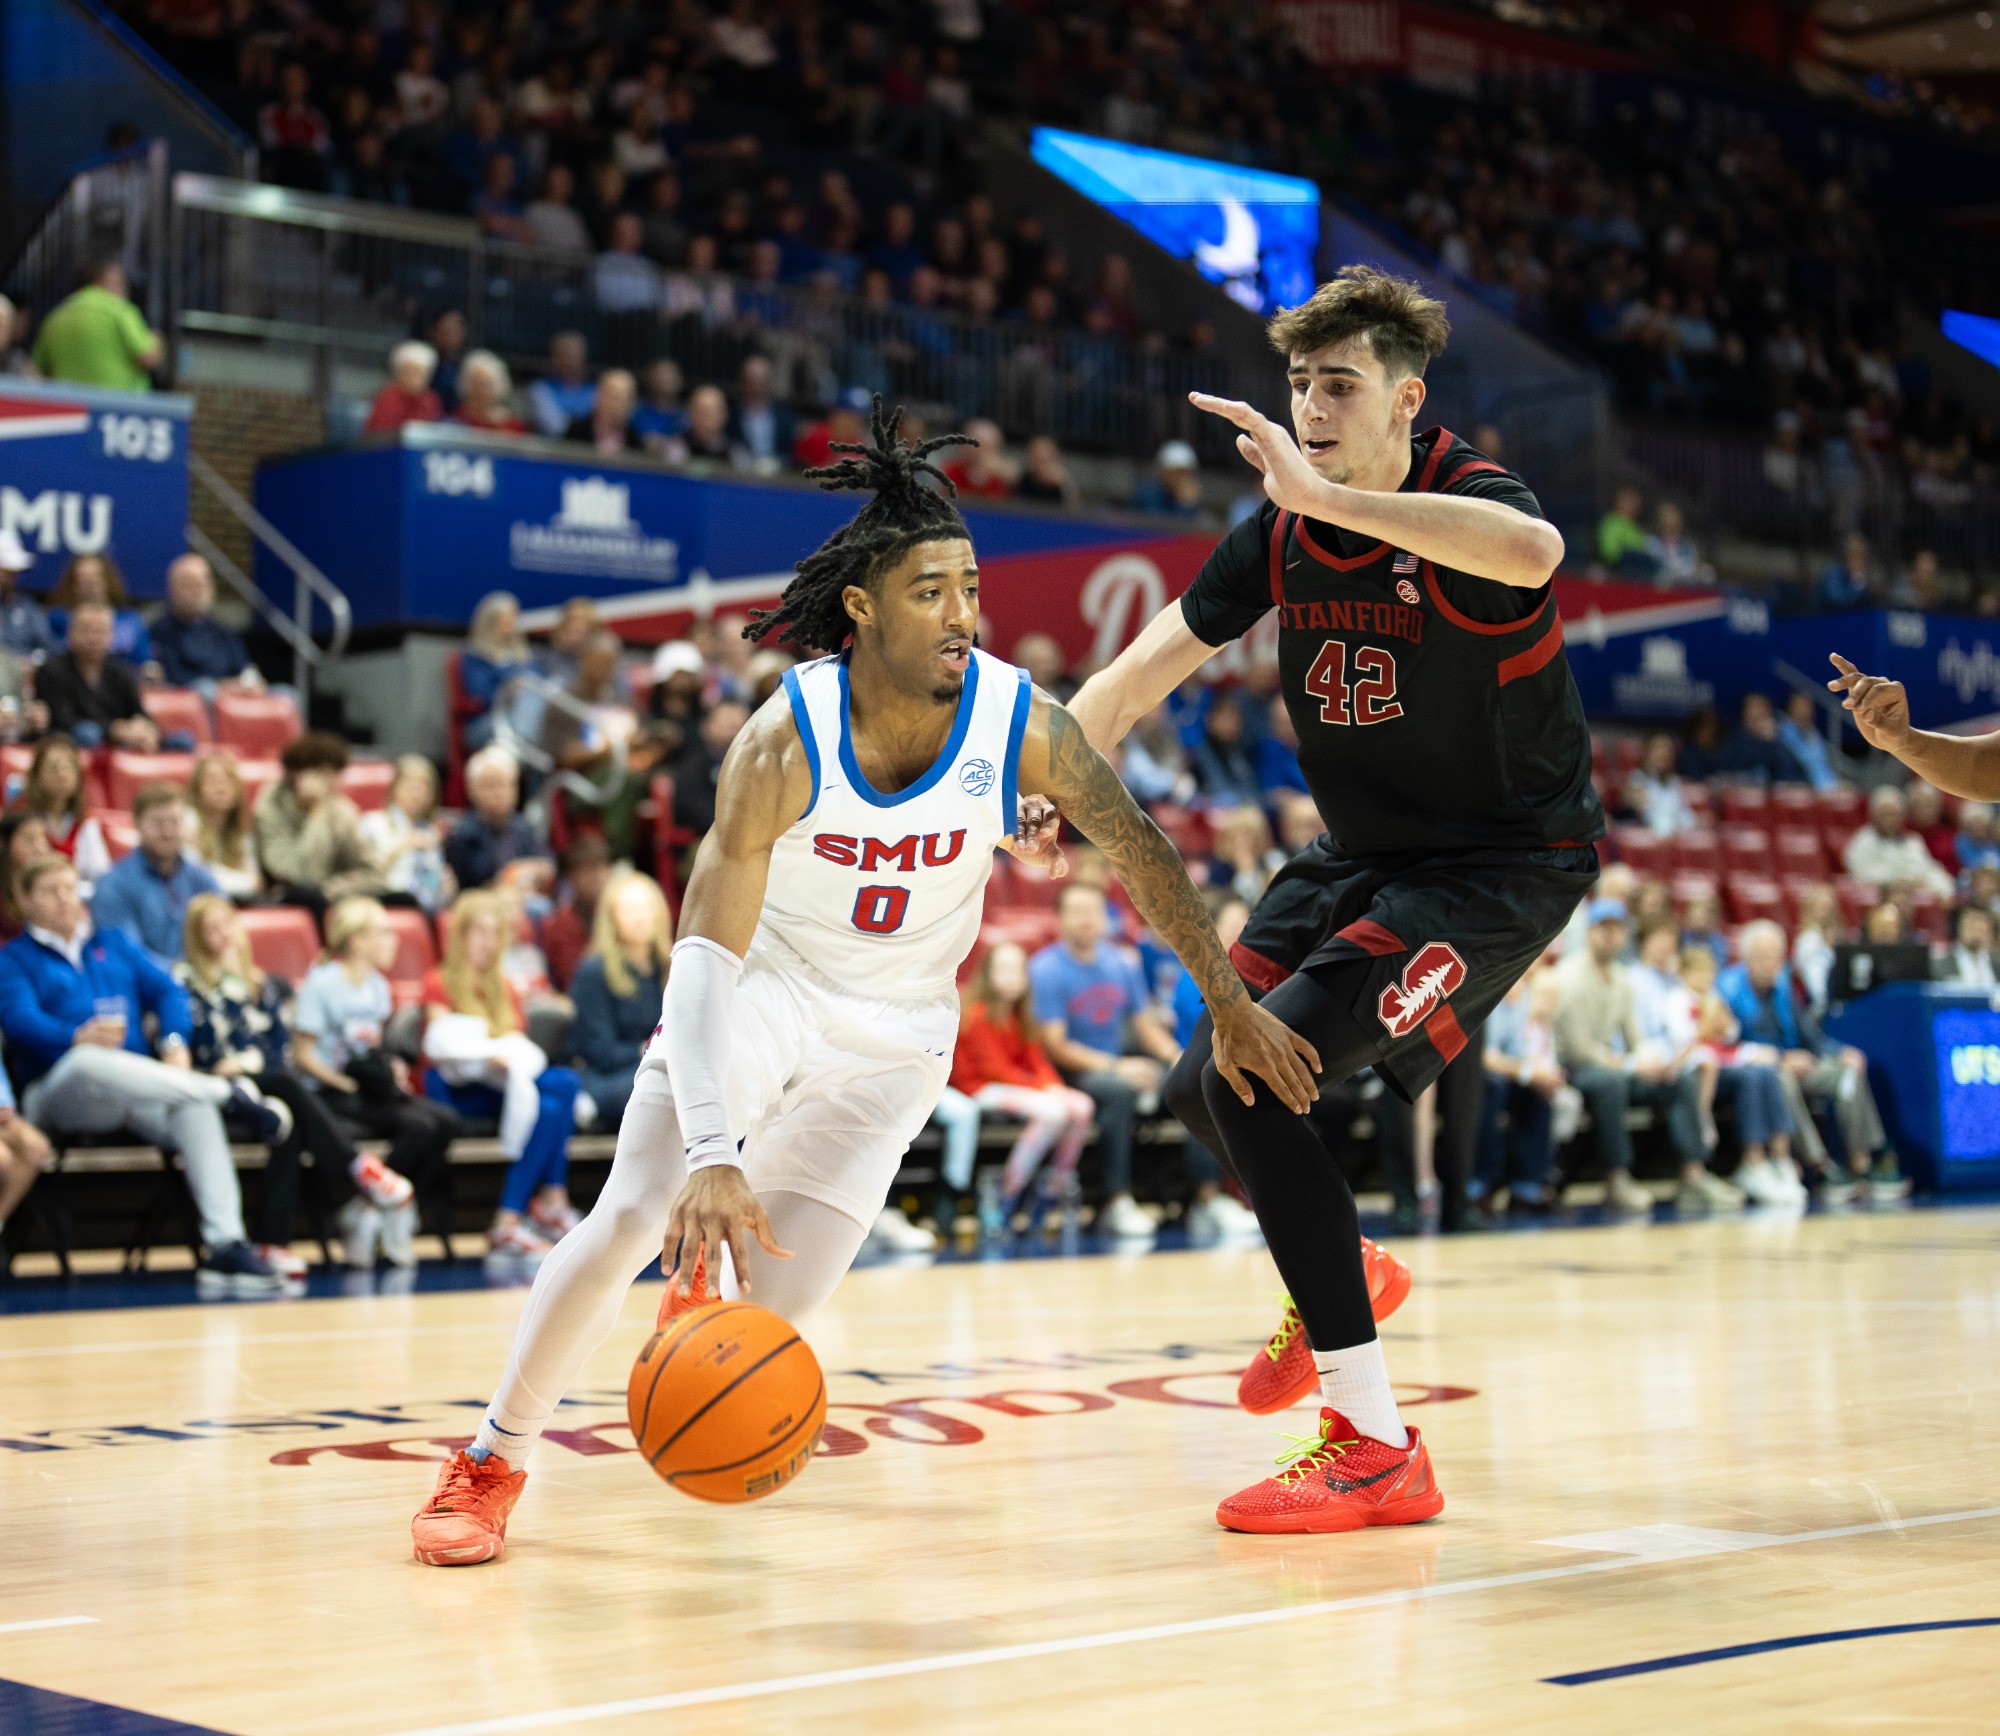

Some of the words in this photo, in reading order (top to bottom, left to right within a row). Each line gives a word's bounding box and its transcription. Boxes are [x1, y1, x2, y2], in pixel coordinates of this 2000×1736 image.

[100, 414, 172, 462] 103
[1279, 600, 1424, 645] STANFORD
[1306, 639, 1404, 725] 42
[964, 769, 993, 780] ACC
[814, 828, 967, 872] SMU
[851, 884, 911, 934] 0
